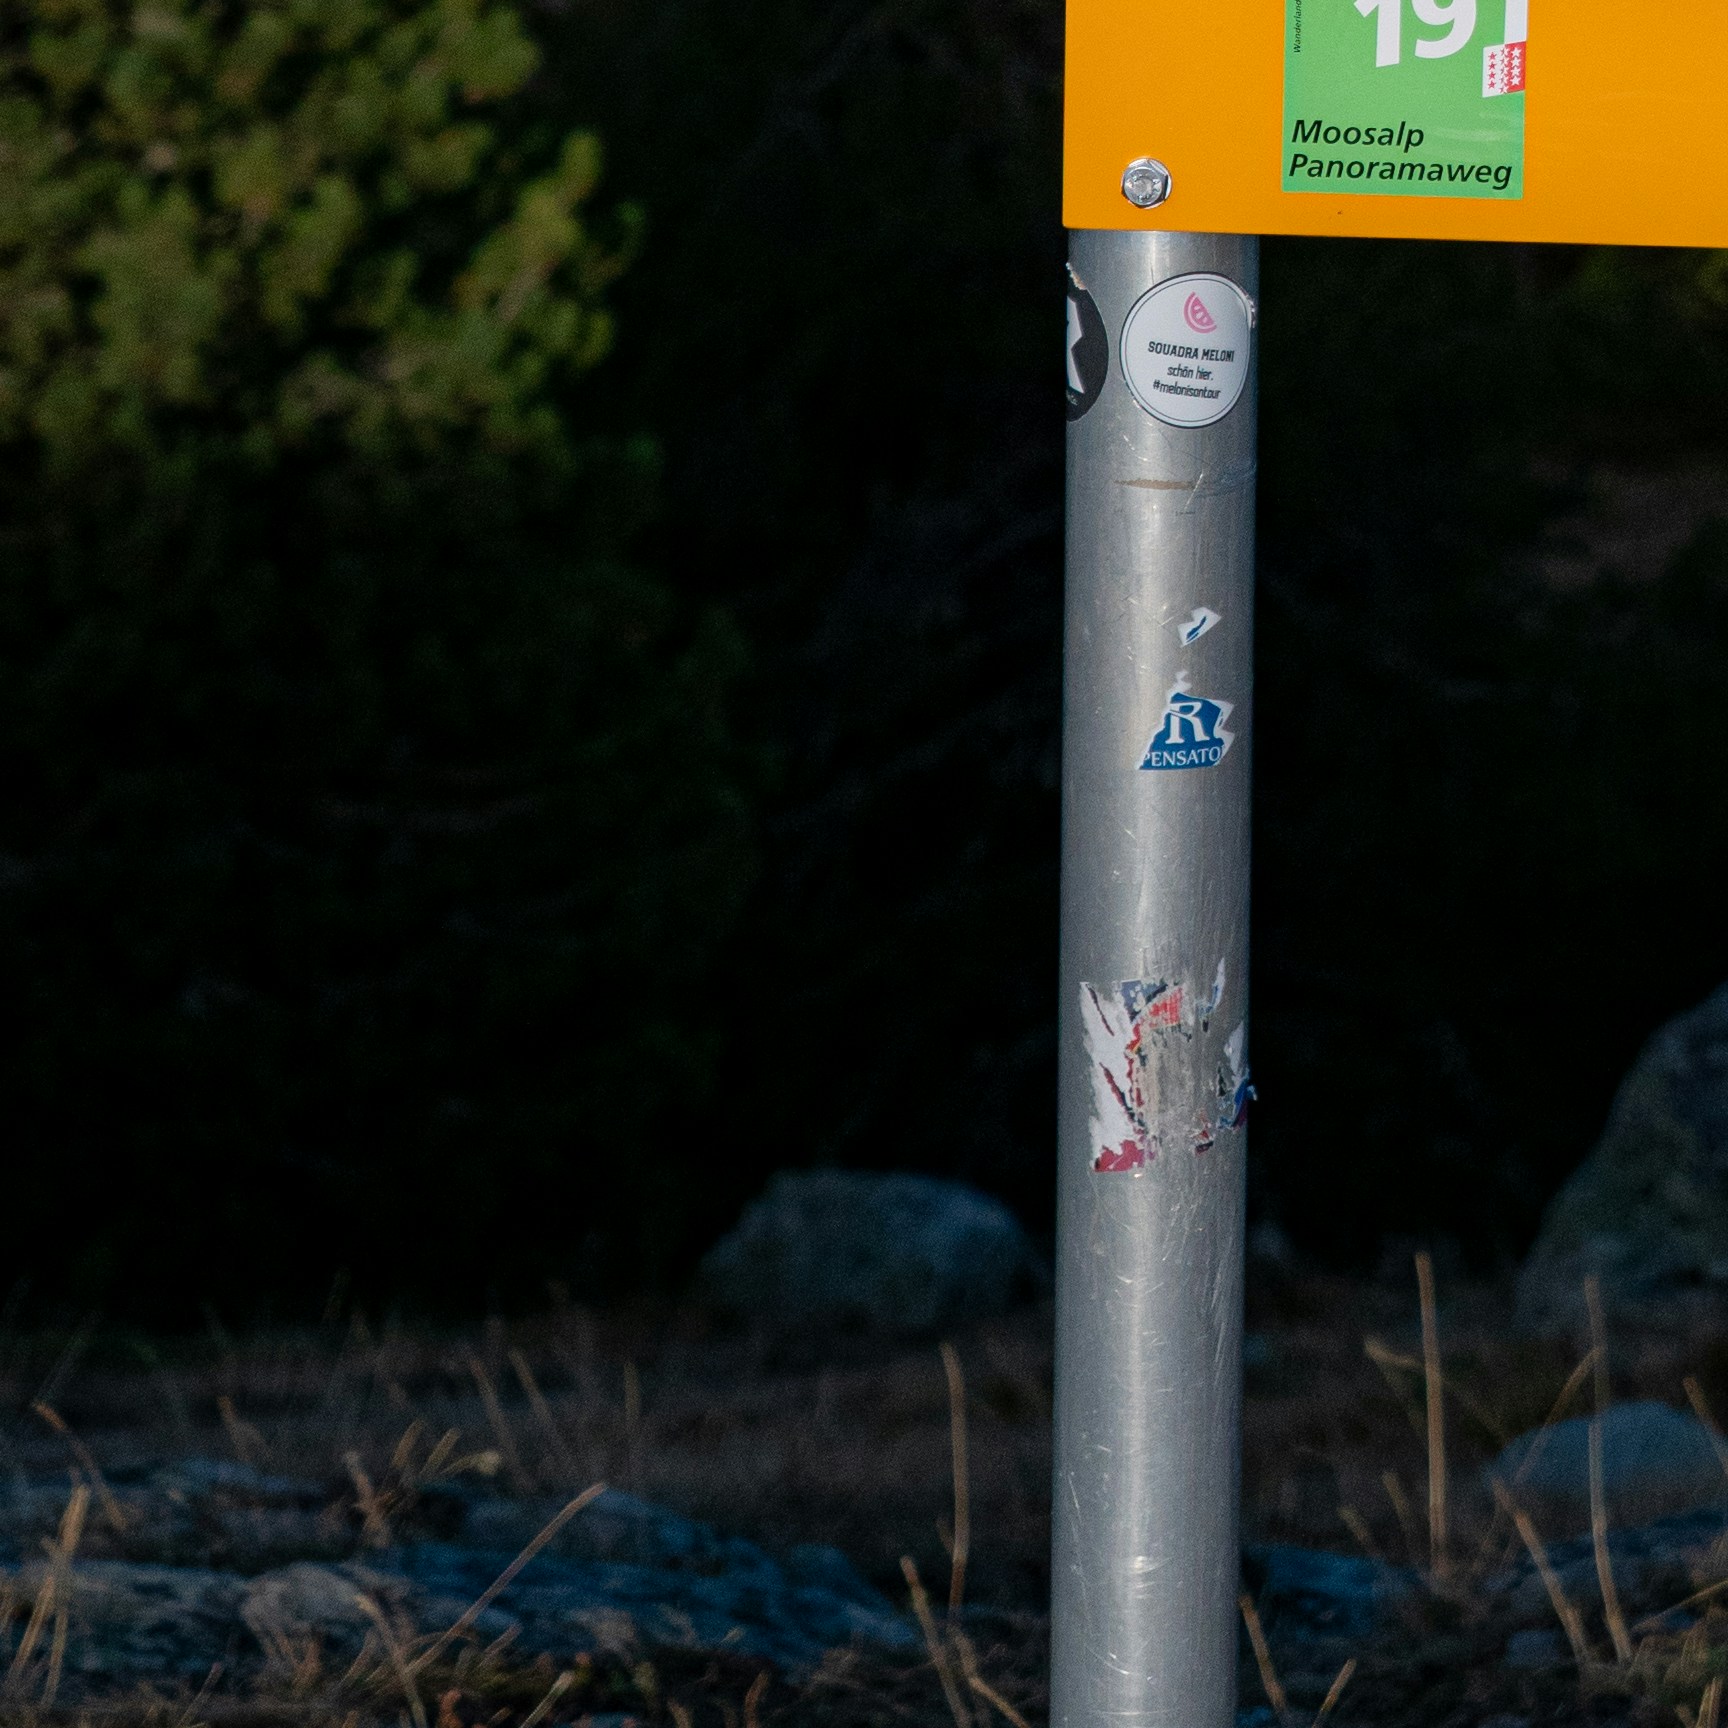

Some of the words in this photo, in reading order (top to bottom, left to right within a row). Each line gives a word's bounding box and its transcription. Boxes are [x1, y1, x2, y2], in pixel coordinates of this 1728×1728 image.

[1293, 0, 1302, 54] Wanderland
[1291, 119, 1424, 154] Moosalp
[1289, 153, 1512, 191] Panoramaweg
[1167, 364, 1194, 379] schön
[1201, 349, 1235, 363] MELONI
